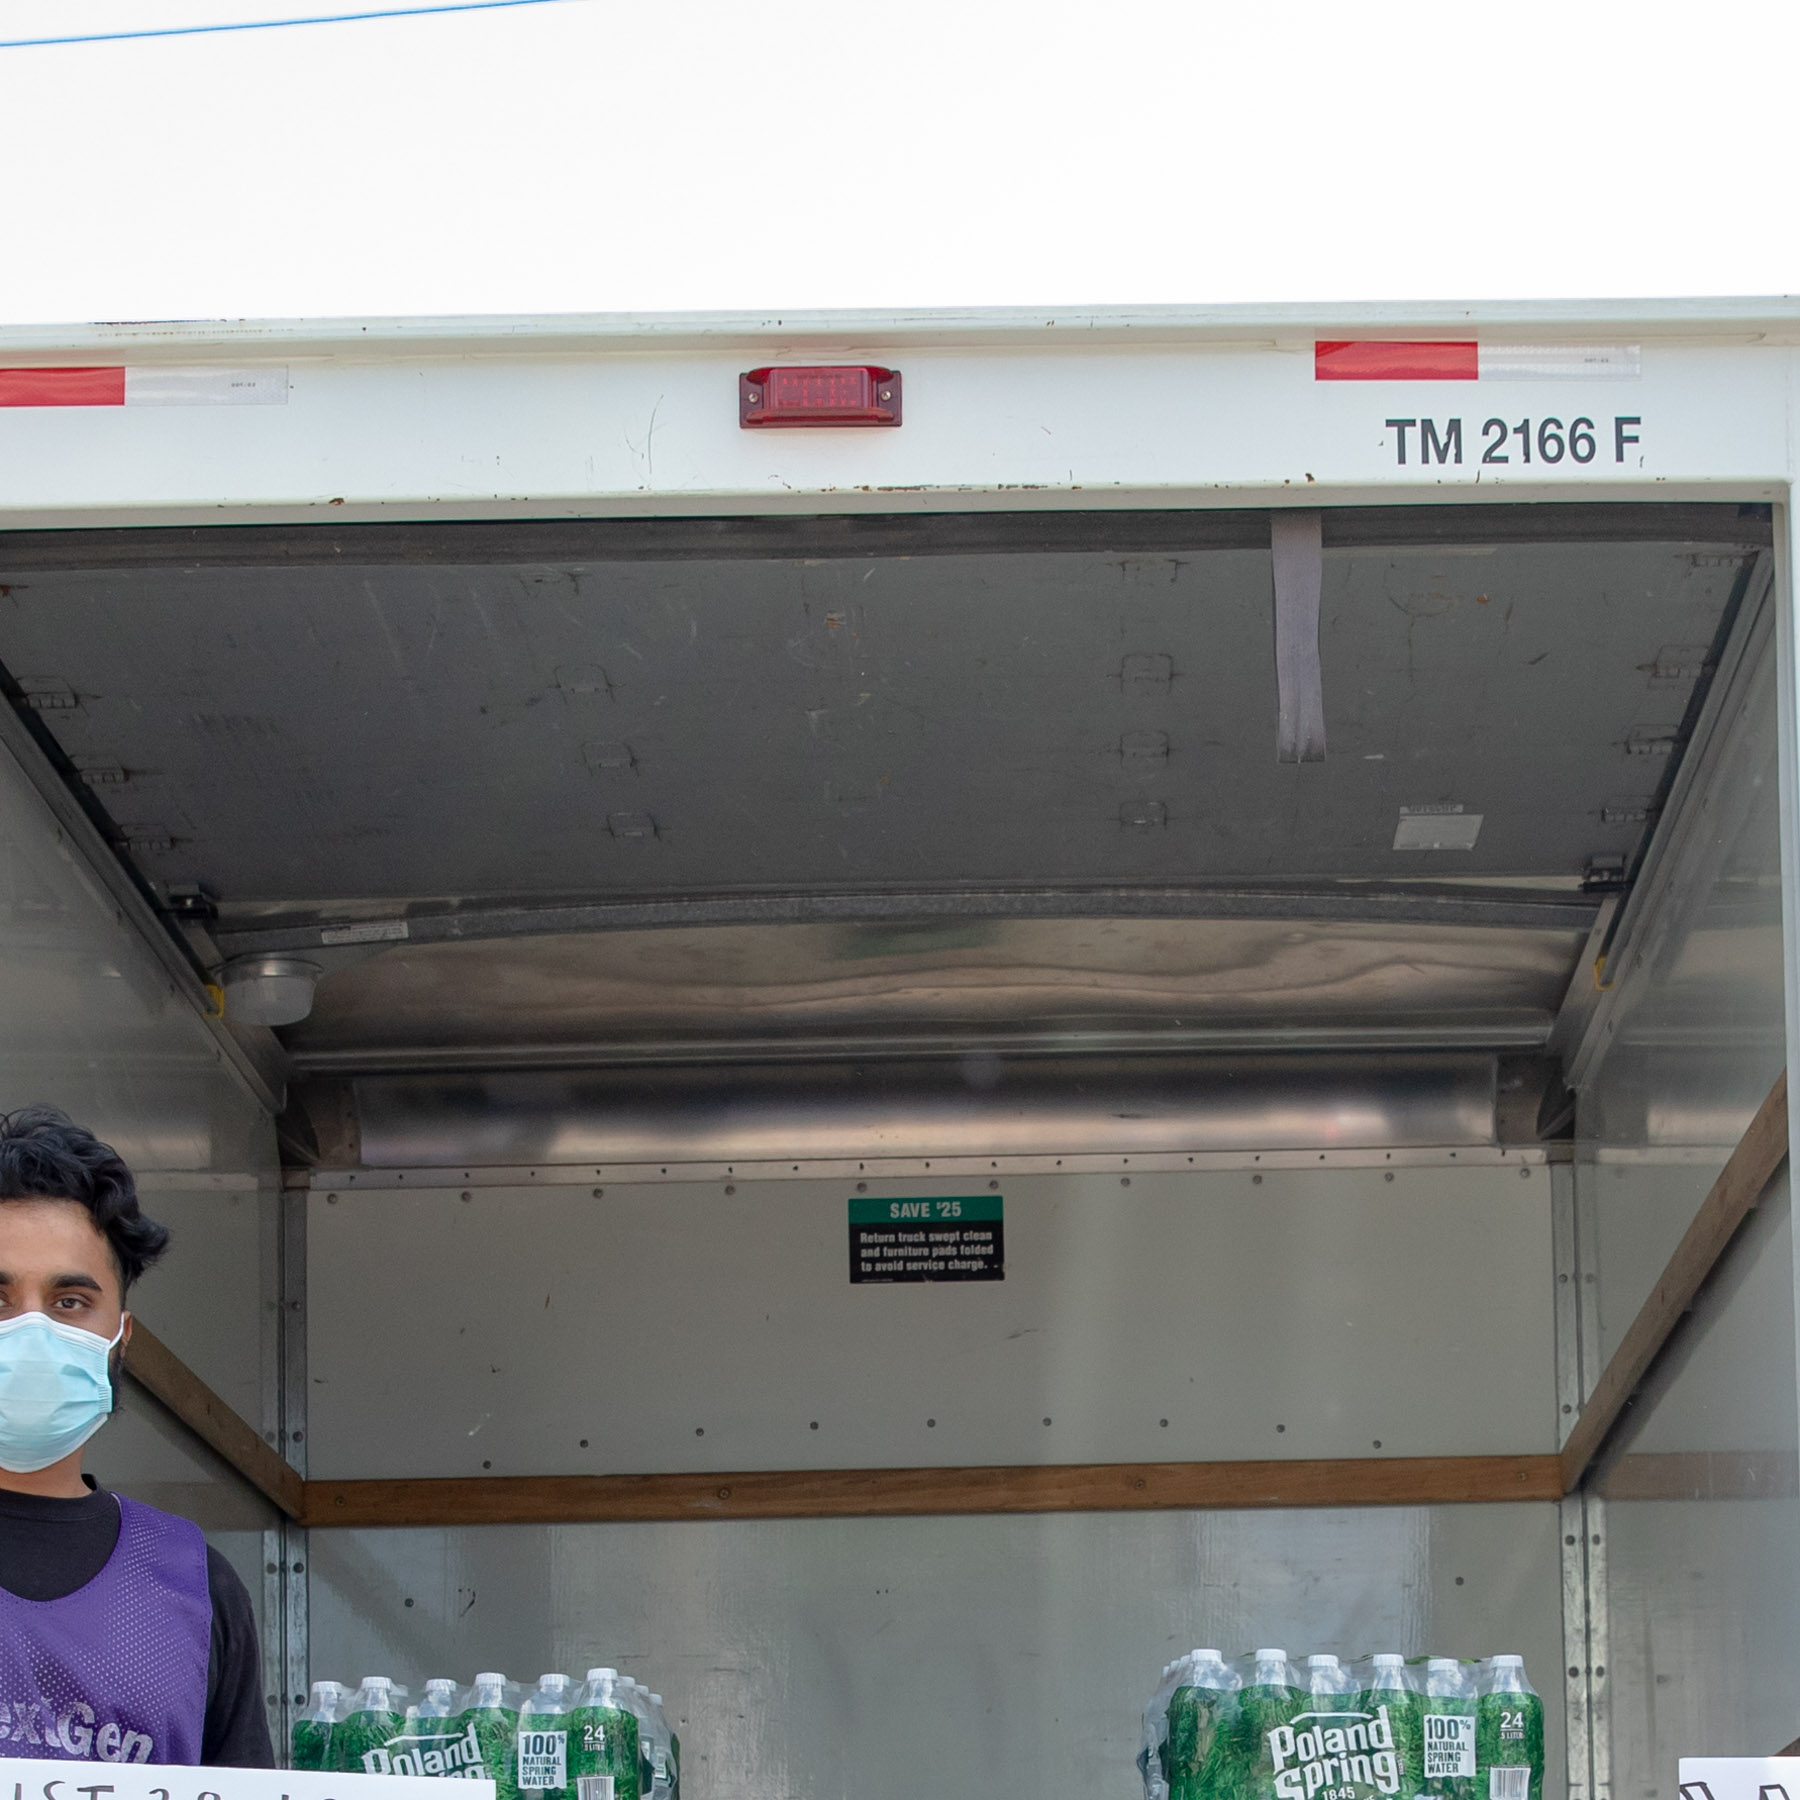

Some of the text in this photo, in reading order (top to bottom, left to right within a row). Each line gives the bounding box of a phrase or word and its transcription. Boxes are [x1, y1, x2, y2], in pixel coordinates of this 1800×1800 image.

[1386, 416, 1641, 464] TM 2166 F
[890, 1202, 961, 1218] SAVE $25
[861, 1231, 992, 1243] Return truck swept clean
[861, 1245, 993, 1257] and furniture pads folded
[861, 1258, 987, 1271] to avoid service charge.
[1500, 1712, 1524, 1728] 24
[1427, 1717, 1471, 1740] 100%
[1268, 1706, 1394, 1775] Poland
[1428, 1741, 1469, 1752] NATURAL
[1428, 1752, 1461, 1763] SPRING
[1428, 1763, 1458, 1774] WATER
